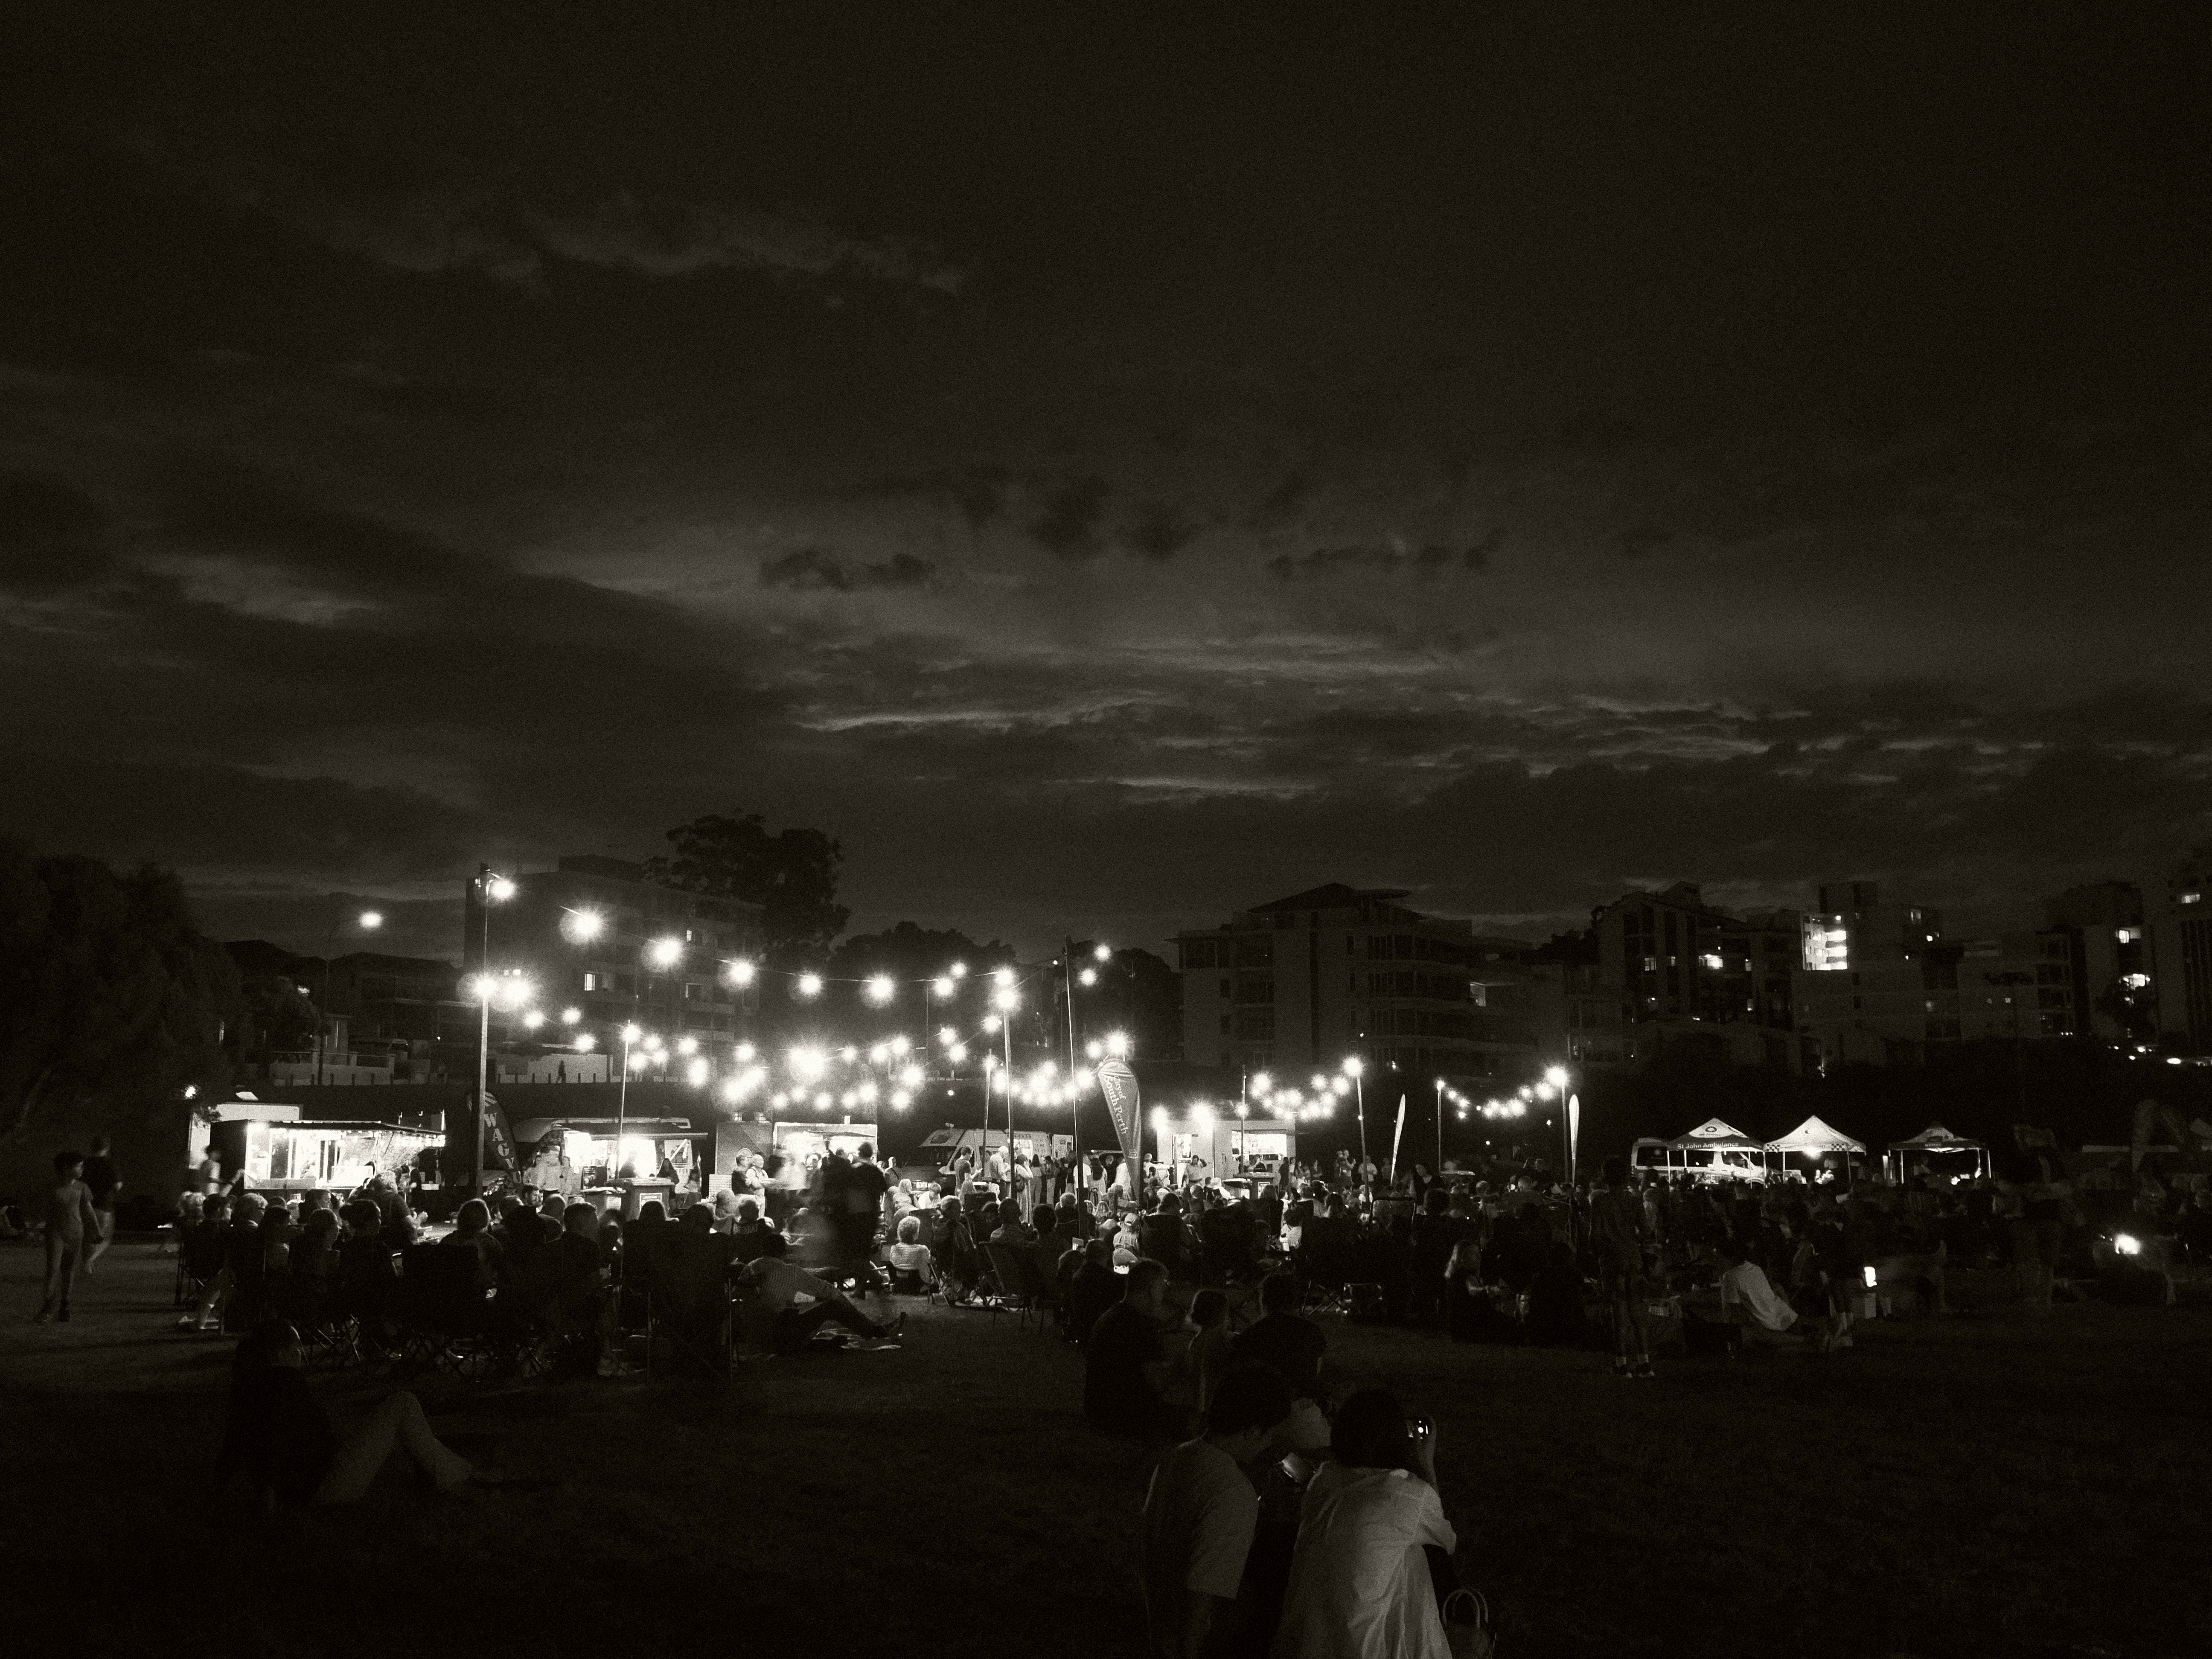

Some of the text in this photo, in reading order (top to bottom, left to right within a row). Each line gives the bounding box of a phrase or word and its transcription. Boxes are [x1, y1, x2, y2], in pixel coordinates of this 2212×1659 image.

[1105, 1076, 1129, 1134] South Perth
[1118, 1091, 1126, 1099] of
